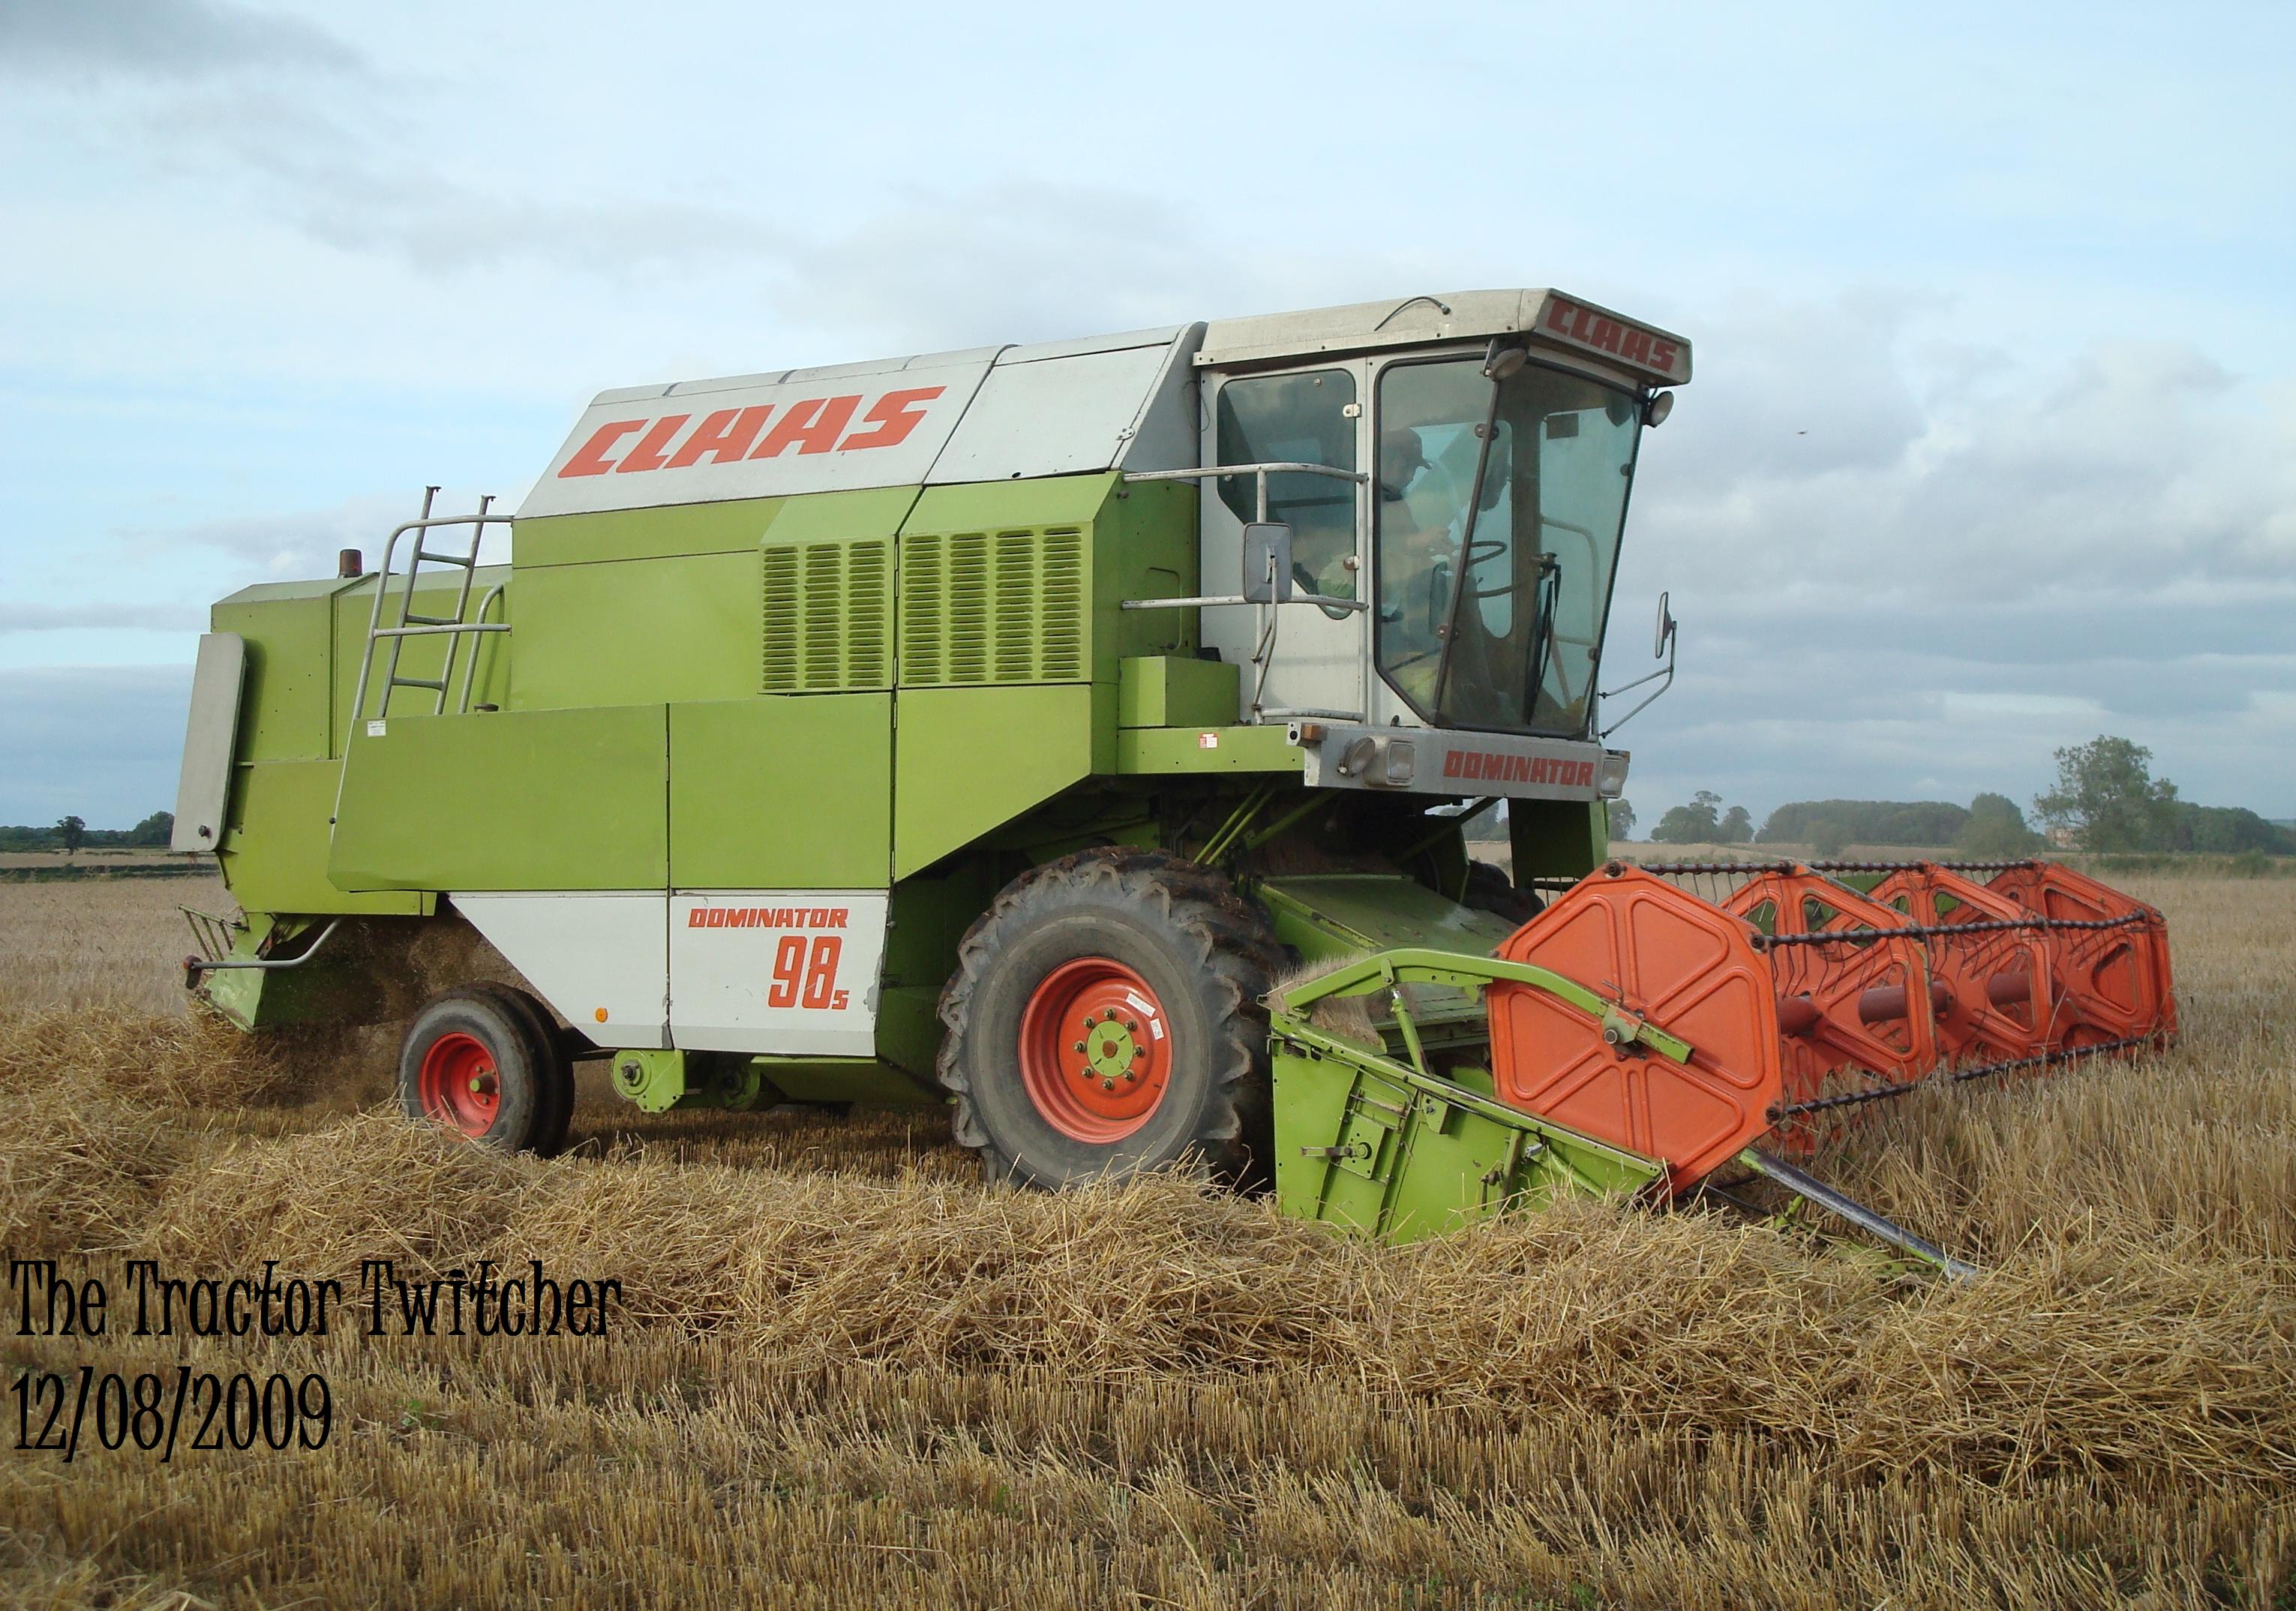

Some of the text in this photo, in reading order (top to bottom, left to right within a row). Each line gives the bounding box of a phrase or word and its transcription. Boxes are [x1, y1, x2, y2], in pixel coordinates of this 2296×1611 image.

[1547, 300, 1678, 372] CLAAS
[557, 386, 947, 478] CLAAS
[1443, 750, 1594, 787] DOMINATOR
[689, 908, 848, 928] DOMINATOR
